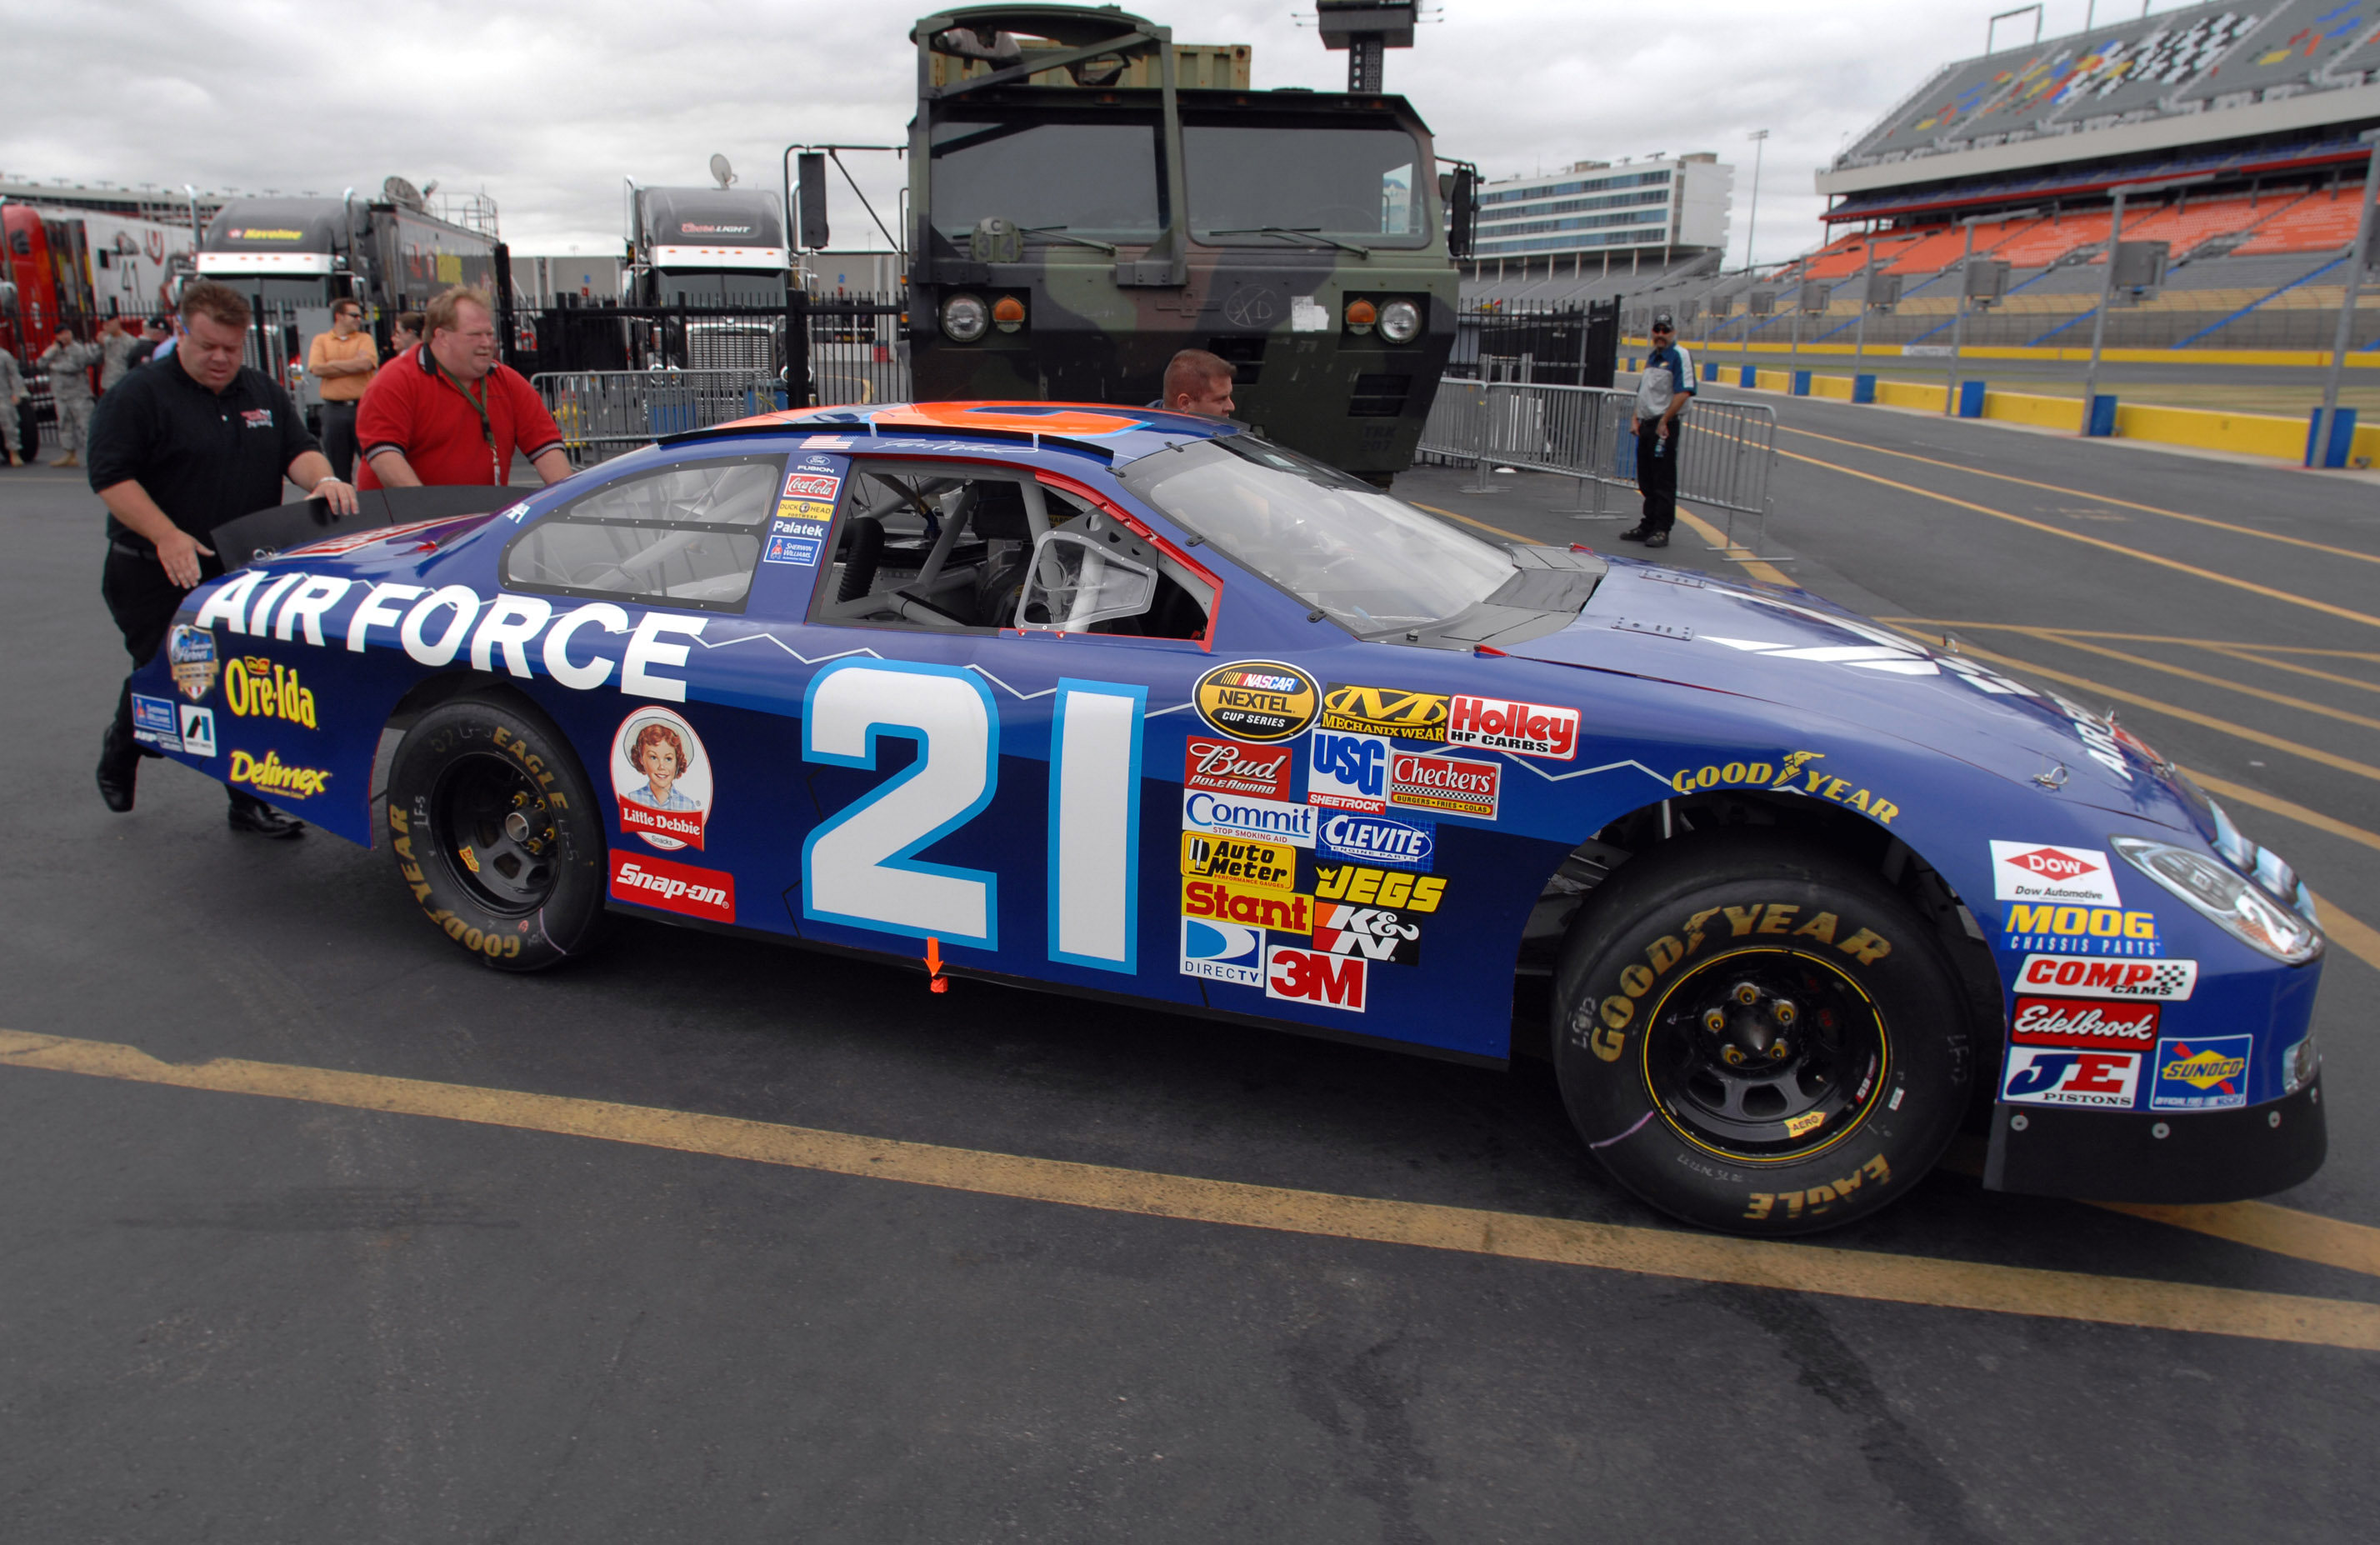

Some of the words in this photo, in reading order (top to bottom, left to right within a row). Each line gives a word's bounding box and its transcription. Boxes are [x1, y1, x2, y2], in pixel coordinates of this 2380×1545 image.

[715, 225, 751, 233] LIGHT
[797, 465, 834, 473] FUSION
[811, 506, 832, 514] HEAD
[772, 521, 824, 538] Palatek
[195, 571, 352, 647] AIR
[347, 581, 708, 702] FORCE
[1242, 672, 1296, 692] NASCAR
[1218, 689, 1292, 714] NEXTEL
[1222, 711, 1244, 722] CUP
[1246, 715, 1286, 728] SERIES
[1322, 712, 1399, 738] MECHANIX
[1401, 725, 1446, 742] WEAR
[1452, 697, 1575, 755] Holley
[1451, 731, 1477, 742] HP
[1481, 735, 1548, 752] CARBS
[493, 726, 570, 810] EAGLE
[1189, 742, 1288, 779] Bud
[1312, 733, 1385, 796] USG
[229, 750, 328, 797] Delimex
[1188, 774, 1228, 788] POLE
[1227, 779, 1277, 795] AWARD
[1393, 758, 1492, 793] Checkers
[1186, 792, 1311, 834] Commit
[1309, 793, 1380, 812] SHEETROCK
[1397, 795, 1430, 806] BURGERS
[1436, 800, 1458, 810] FRIES
[1464, 804, 1488, 813] COLAS
[623, 808, 655, 828] Little
[656, 814, 701, 836] Debbie
[802, 656, 1148, 975] 21
[651, 835, 673, 847] Snacks
[1213, 826, 1233, 835] STOP
[1235, 830, 1272, 842] SMOKING
[1273, 835, 1288, 843] AID
[1326, 814, 1425, 855] CLEVITE
[1213, 841, 1275, 864] Auto
[1332, 846, 1375, 858] ENGINE
[1379, 852, 1417, 862] PARTS
[1208, 857, 1288, 882] Meter
[1214, 873, 1258, 885] PERFORMANCE
[1259, 880, 1285, 888] GAUGES
[616, 862, 728, 907] Snap-on
[1314, 865, 1448, 912] JEGS
[2015, 885, 2042, 895] Dow
[2043, 887, 2103, 900] Automotive
[1186, 881, 1308, 932] Stant
[2004, 903, 2155, 940] MOOG
[2010, 935, 2090, 952] CHASSIS
[2101, 939, 2157, 957] PARTS
[1184, 960, 1259, 983] DIRECTV
[1269, 949, 1365, 1009] 3M
[2026, 959, 2153, 988] COMP
[2110, 985, 2175, 996] CAMS
[2013, 1005, 2154, 1041] Edelbrock
[2006, 1052, 2133, 1097] JE
[2168, 1061, 2243, 1078] SUNOCO
[2042, 1092, 2133, 1107] PISTONS
[1792, 1115, 1819, 1132] AERO
[1742, 1152, 1892, 1220] EAGLE
